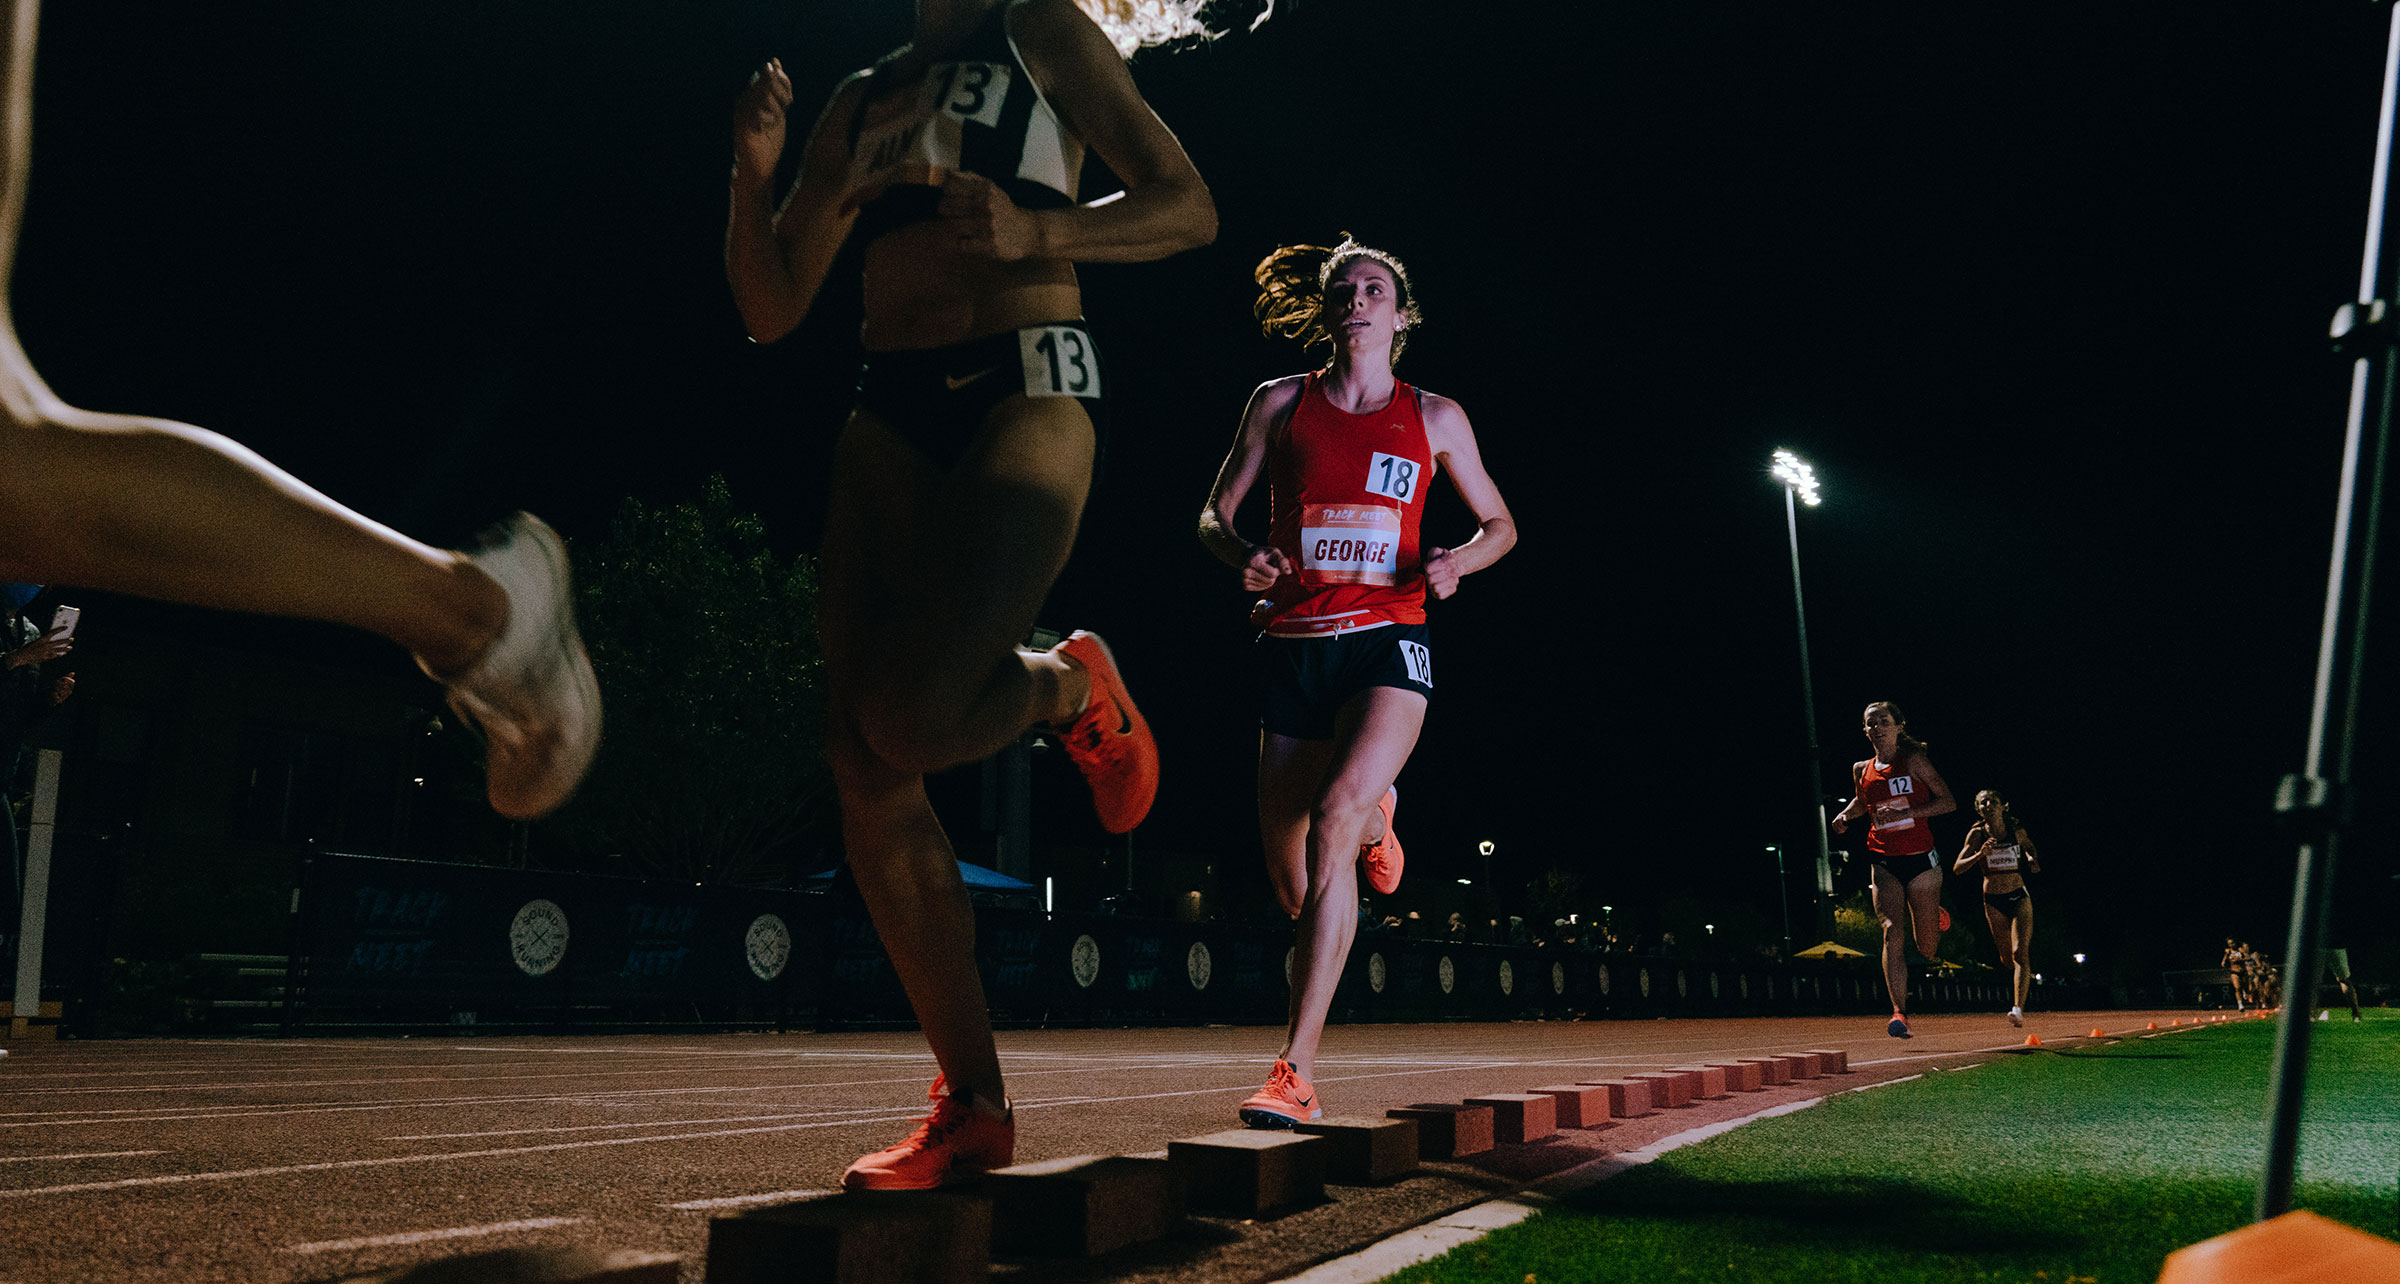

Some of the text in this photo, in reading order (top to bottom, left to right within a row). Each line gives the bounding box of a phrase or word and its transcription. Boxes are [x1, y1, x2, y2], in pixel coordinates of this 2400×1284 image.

[935, 63, 992, 114] 13
[1035, 331, 1088, 392] 13
[1380, 457, 1412, 498] 18
[1322, 508, 1356, 521] TRACK
[1315, 539, 1389, 564] GEORGE
[1409, 644, 1428, 682] 18
[1892, 777, 1910, 793] 12
[522, 908, 559, 926] SOUND
[753, 921, 783, 937] SOUND
[515, 943, 561, 968] RUNNING
